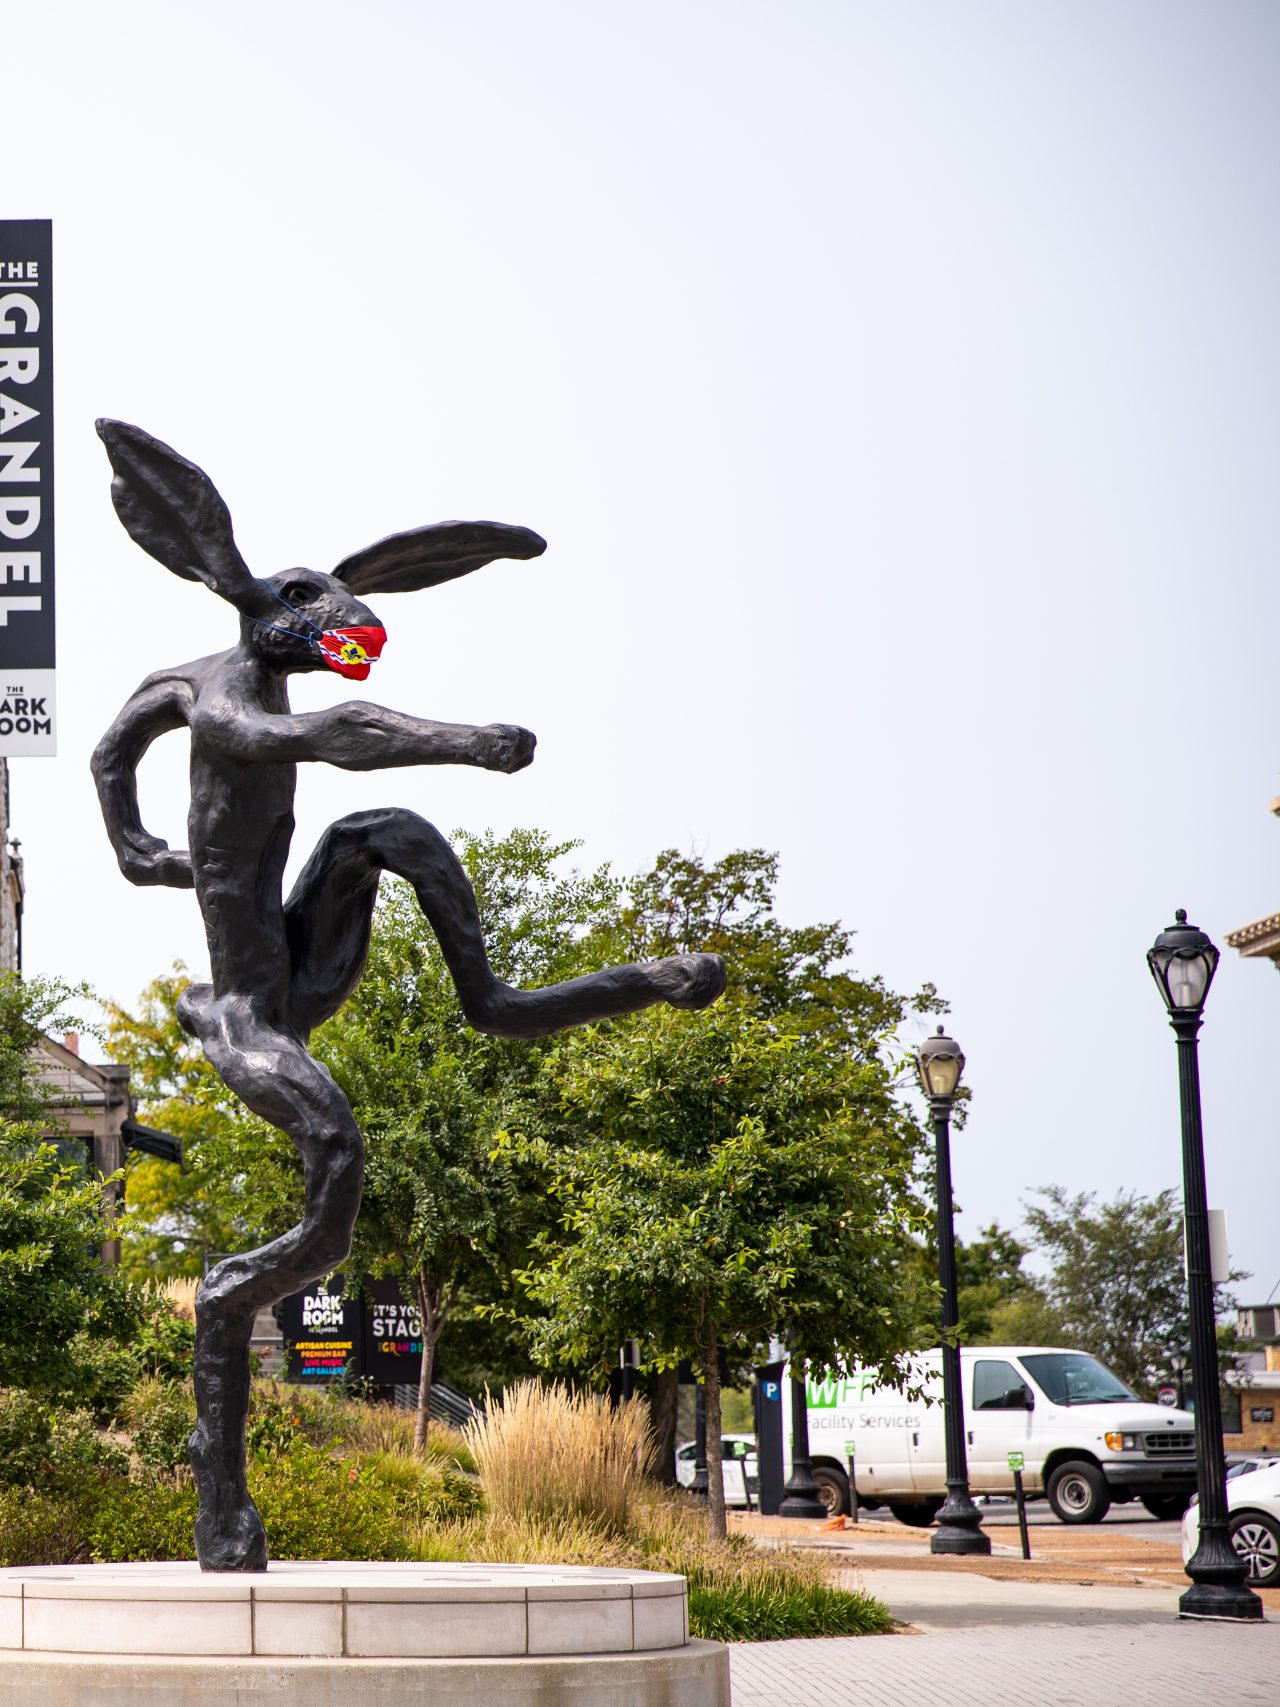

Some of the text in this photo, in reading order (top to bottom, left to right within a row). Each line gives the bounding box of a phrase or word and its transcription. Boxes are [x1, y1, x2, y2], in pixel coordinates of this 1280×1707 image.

[304, 1295, 341, 1310] DARK
[303, 1310, 344, 1326] ROOM
[373, 1304, 397, 1317] IT'S
[373, 1318, 421, 1338] STAG
[382, 1341, 423, 1356] GRANDE
[767, 1383, 777, 1398] P
[859, 1413, 921, 1429] Services
